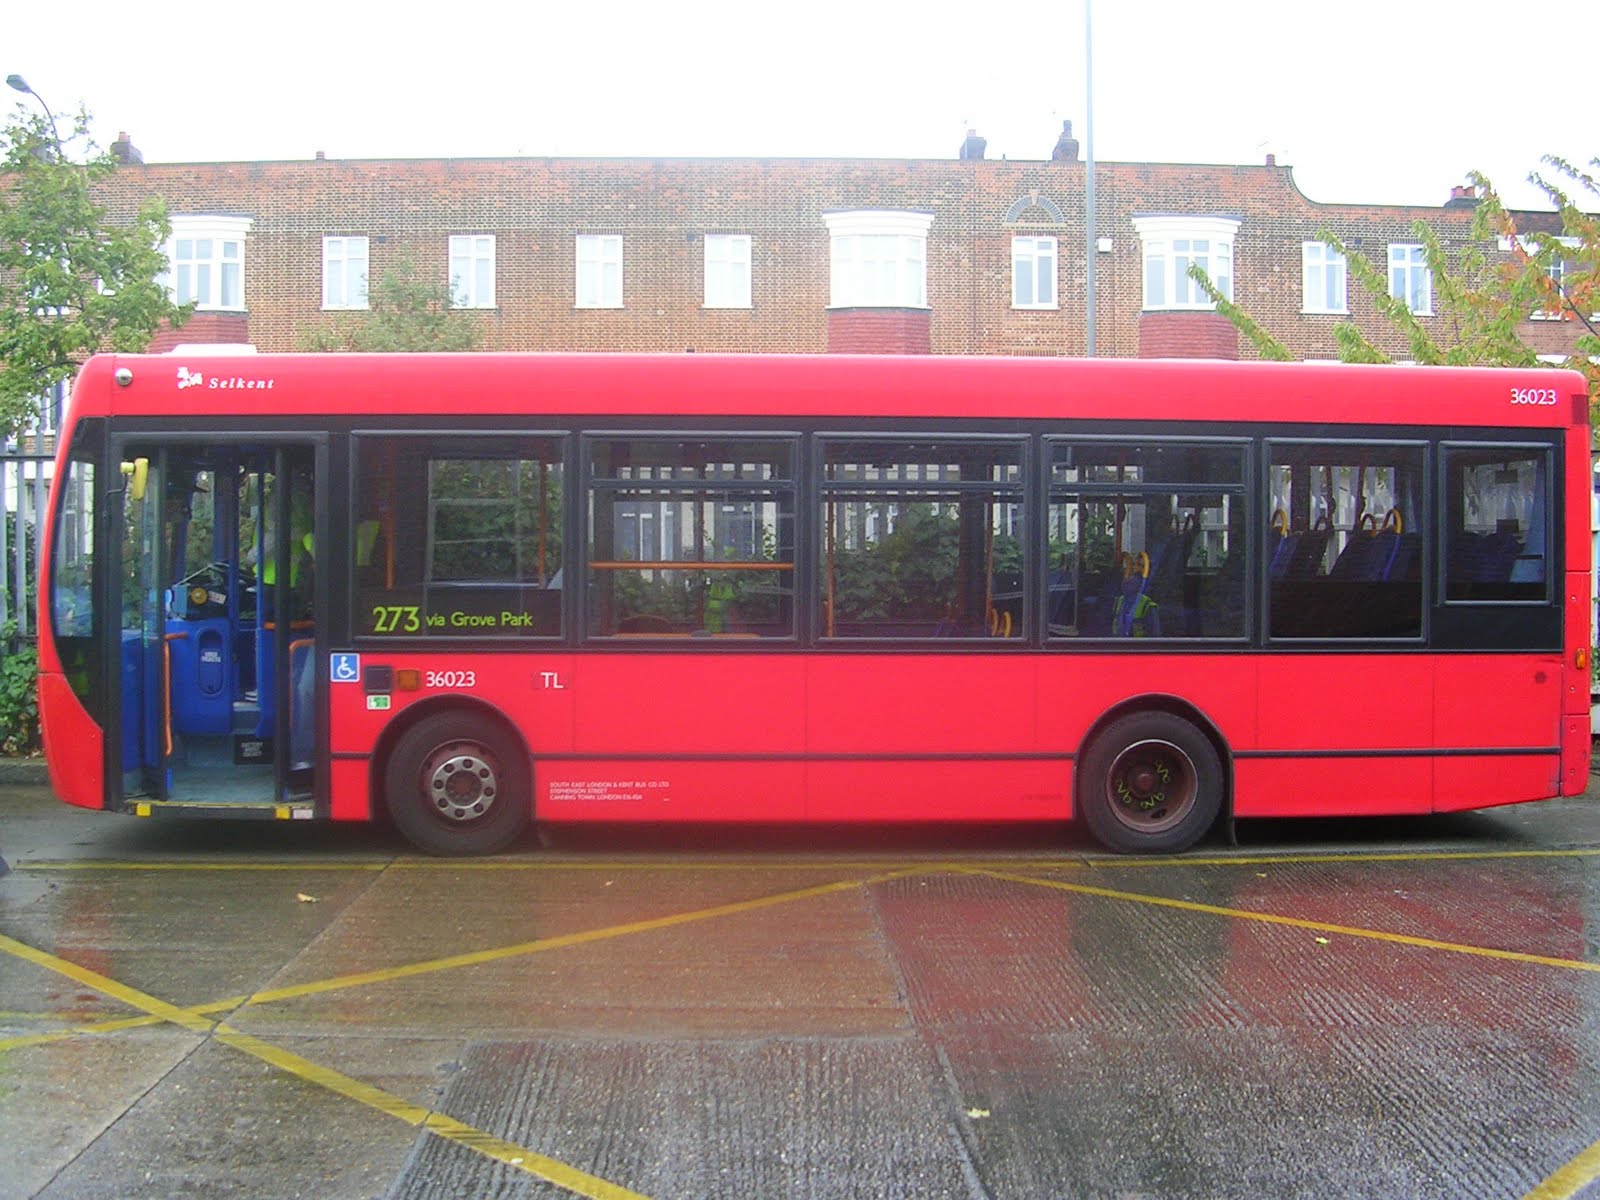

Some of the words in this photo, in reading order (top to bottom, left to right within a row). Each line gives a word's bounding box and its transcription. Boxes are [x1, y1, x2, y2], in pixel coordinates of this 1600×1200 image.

[208, 377, 274, 389] Selkent
[1510, 388, 1557, 405] 36023
[372, 606, 420, 632] 273
[425, 612, 446, 626] via
[450, 611, 496, 626] Grove
[501, 611, 533, 626] Park
[425, 671, 476, 687] 36023
[540, 672, 564, 689] TL
